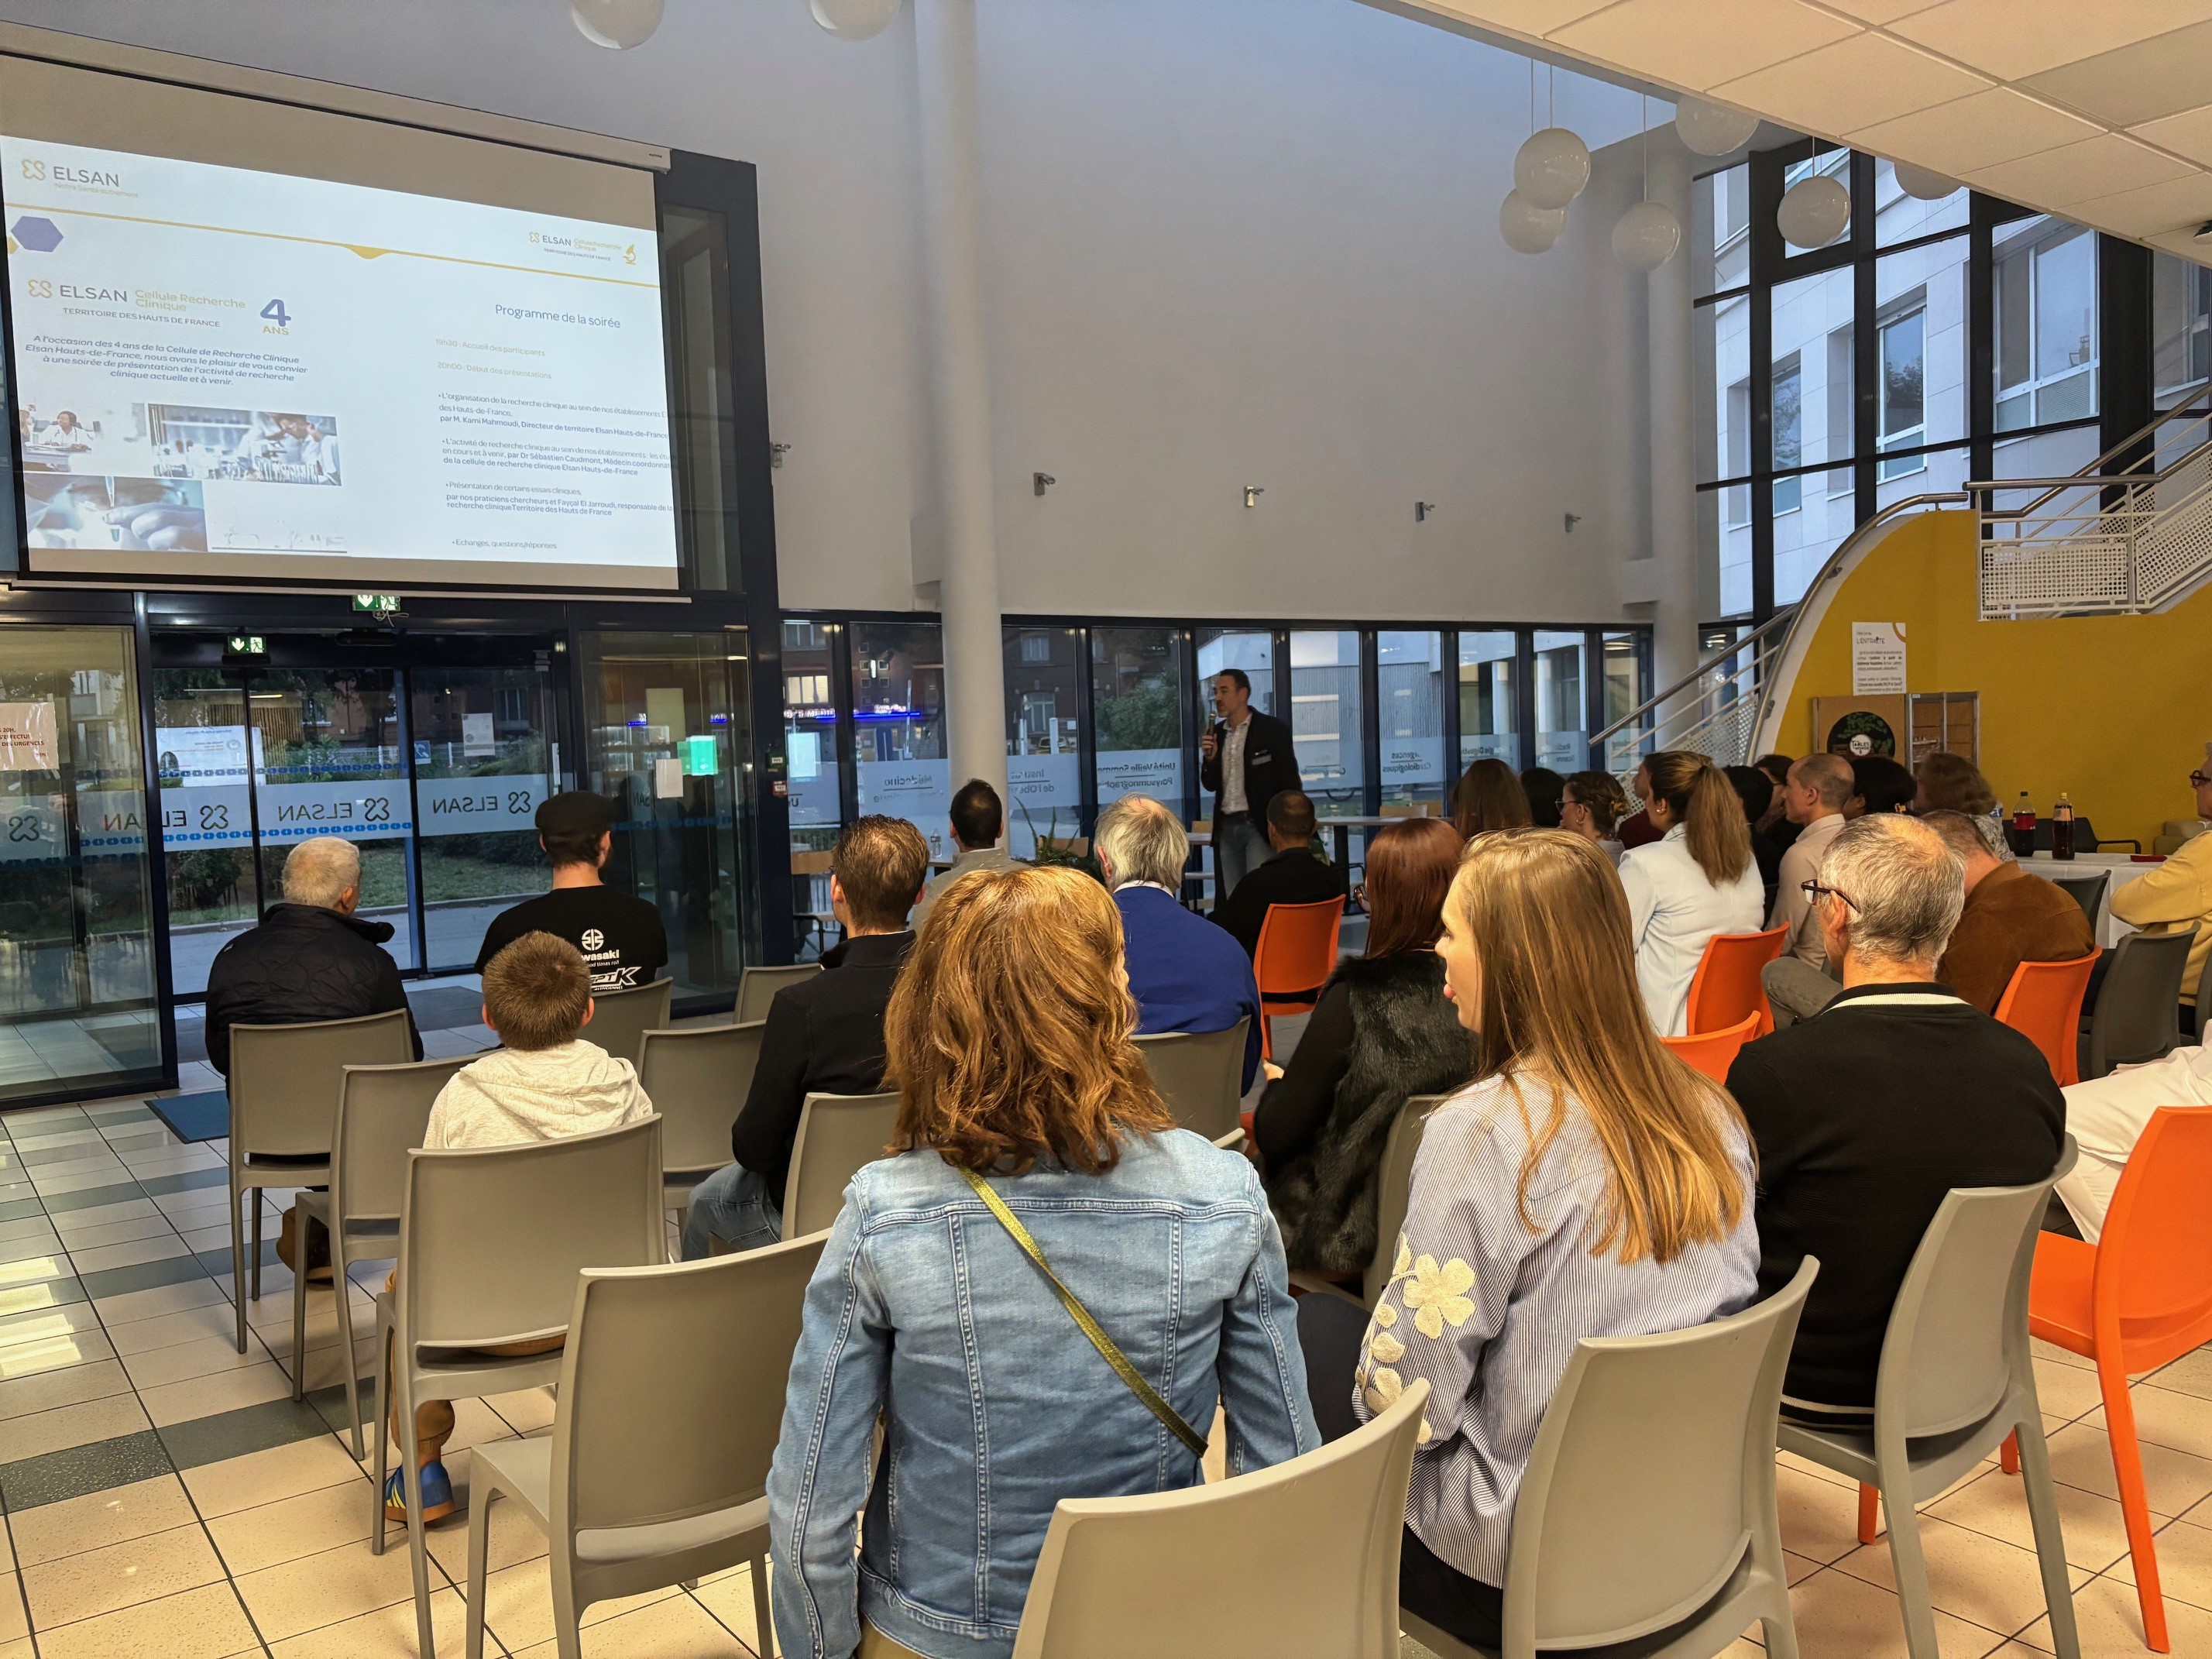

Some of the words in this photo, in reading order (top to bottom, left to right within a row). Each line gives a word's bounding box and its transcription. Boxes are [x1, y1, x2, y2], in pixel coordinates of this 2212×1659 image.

[53, 167, 118, 187] ELSAN
[542, 235, 571, 246] ELSAN
[60, 285, 127, 302] ELSAN
[135, 289, 177, 301] Cellule
[180, 294, 246, 307] Recherche
[135, 299, 186, 311] Clinique
[259, 298, 291, 327] 4
[62, 307, 116, 318] TERRITOIRE
[138, 314, 169, 322] HAUTS
[184, 318, 219, 327] FRANCE
[495, 304, 559, 321] Programme
[561, 312, 575, 323] de
[578, 314, 586, 324] la
[588, 317, 620, 328] soirée
[262, 326, 288, 335] ANS
[26, 344, 53, 352] Elsan
[55, 346, 142, 362] Hauts-de-France,
[208, 359, 237, 368] plaisir
[42, 336, 92, 346] l'occasion
[212, 349, 261, 359] Recherche
[263, 354, 299, 363] Clinique
[503, 347, 545, 356] participants
[71, 358, 101, 366] soirée
[117, 362, 178, 372] présentation
[194, 366, 234, 376] l'activité
[248, 372, 294, 380] recherche
[110, 369, 148, 380] clinique
[149, 373, 187, 382] actuelle
[503, 369, 551, 380] présentations
[441, 393, 489, 402] L'organisation
[542, 401, 567, 410] clinique
[613, 407, 660, 417] établissements
[452, 405, 513, 417] Hauts-de-France,
[482, 418, 520, 428] Mahmoudi,
[613, 428, 668, 438] Hauts-de-France
[524, 444, 550, 452] clinique
[597, 449, 646, 458] établissements
[534, 462, 561, 471] clinique
[581, 465, 637, 475] Hauts-de-France
[551, 487, 582, 496] cliniques,
[581, 950, 620, 961] wasaki
